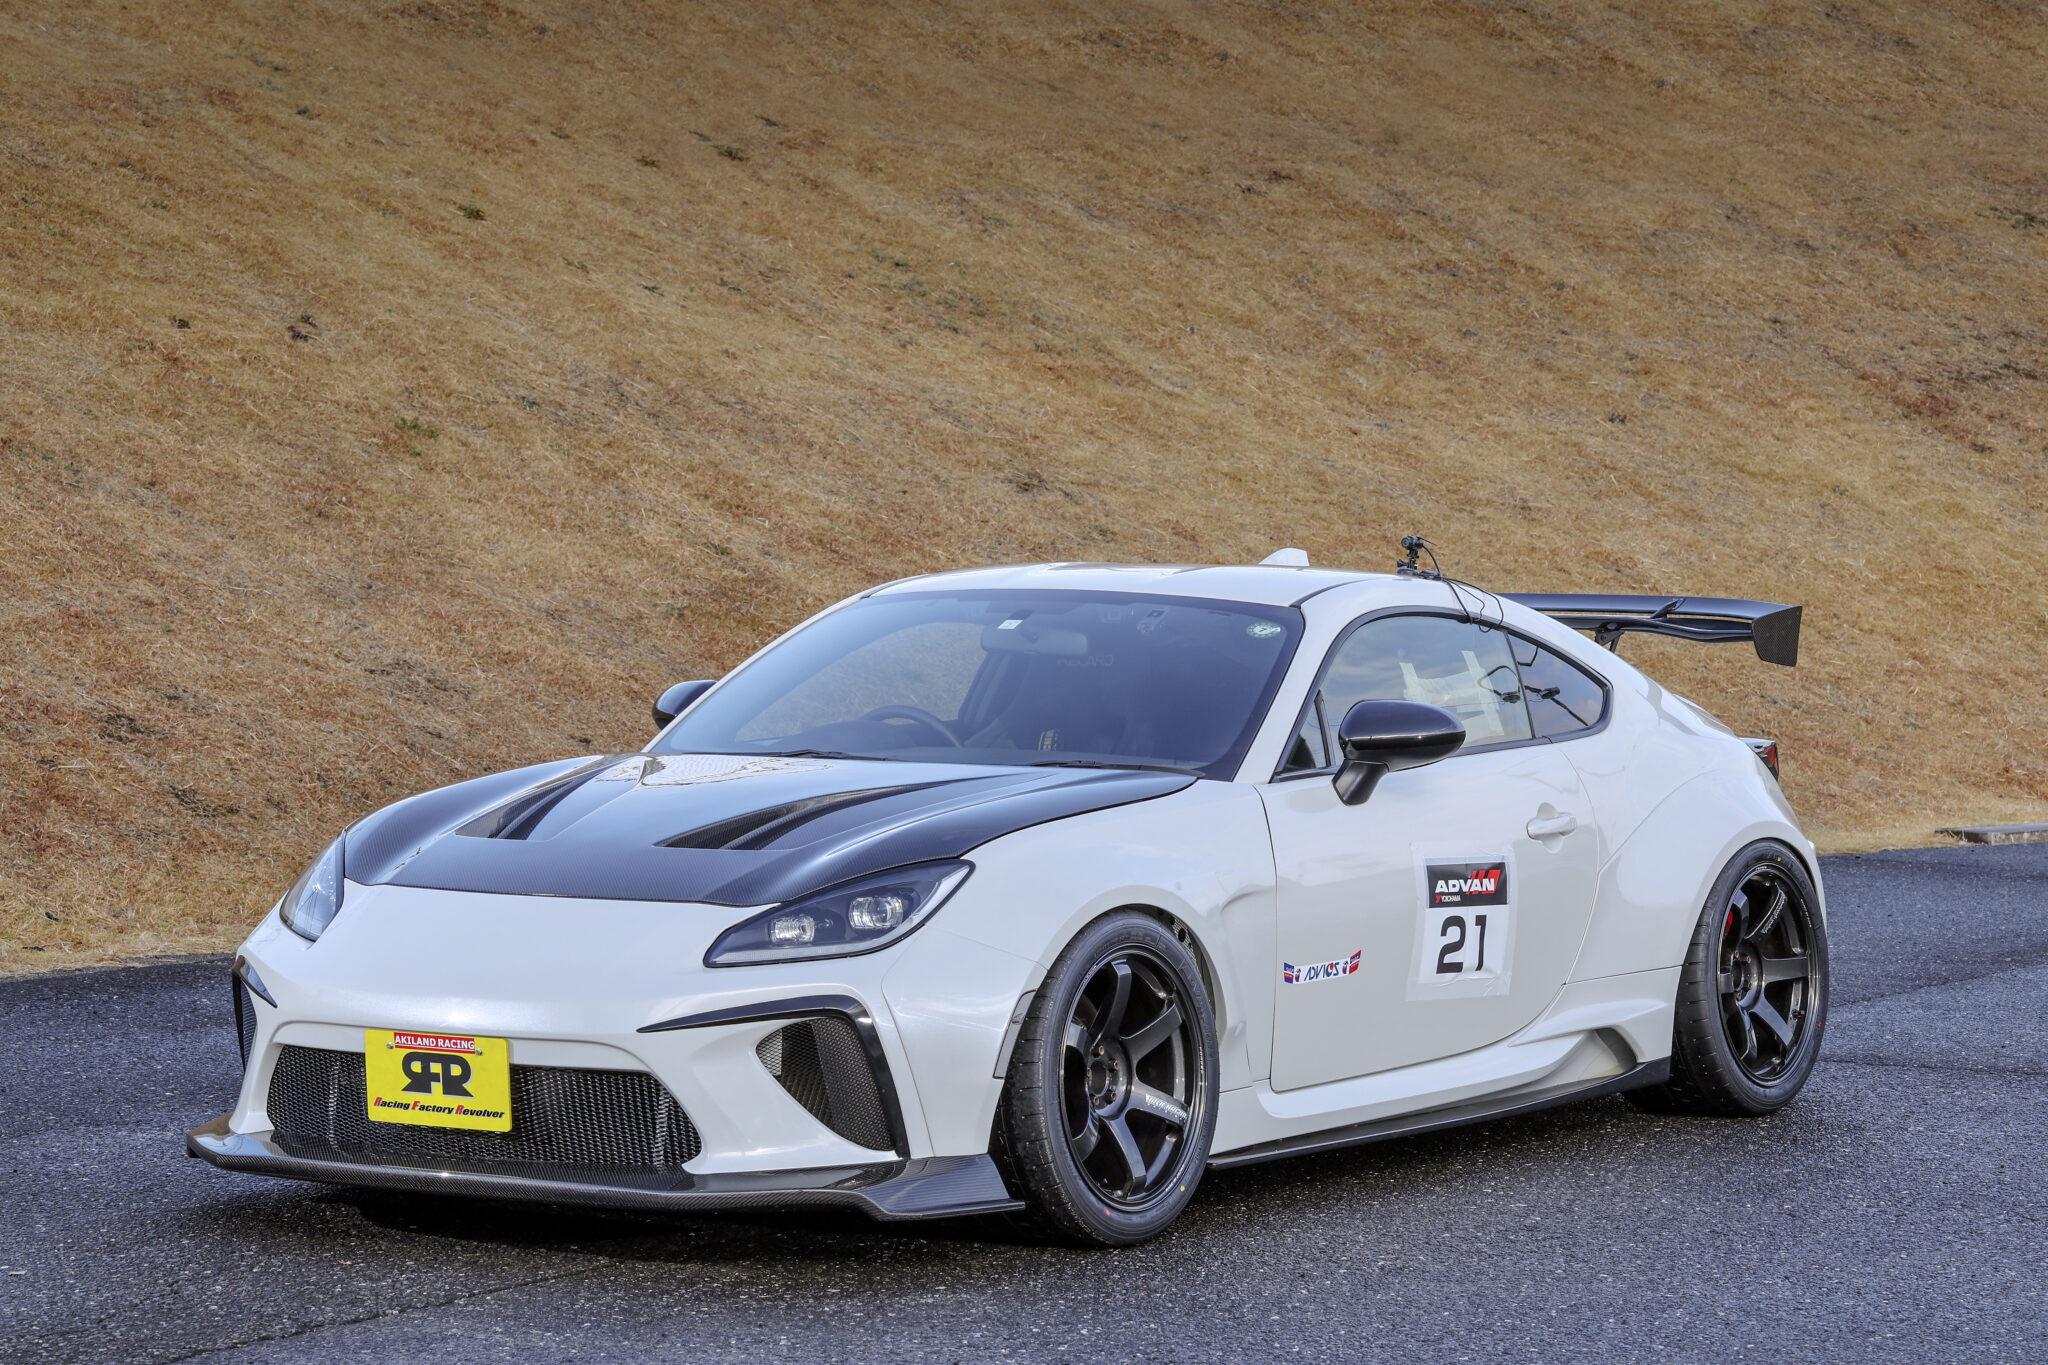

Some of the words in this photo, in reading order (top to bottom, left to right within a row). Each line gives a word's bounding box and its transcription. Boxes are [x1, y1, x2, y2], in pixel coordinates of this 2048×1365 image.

[1434, 878, 1495, 893] ADVAN
[1436, 914, 1487, 974] 21
[395, 1035, 436, 1047] AKILAND
[439, 1038, 475, 1050] RACING
[374, 1097, 411, 1110] Racing
[411, 1101, 454, 1115] Factory
[455, 1105, 505, 1119] Revolver
